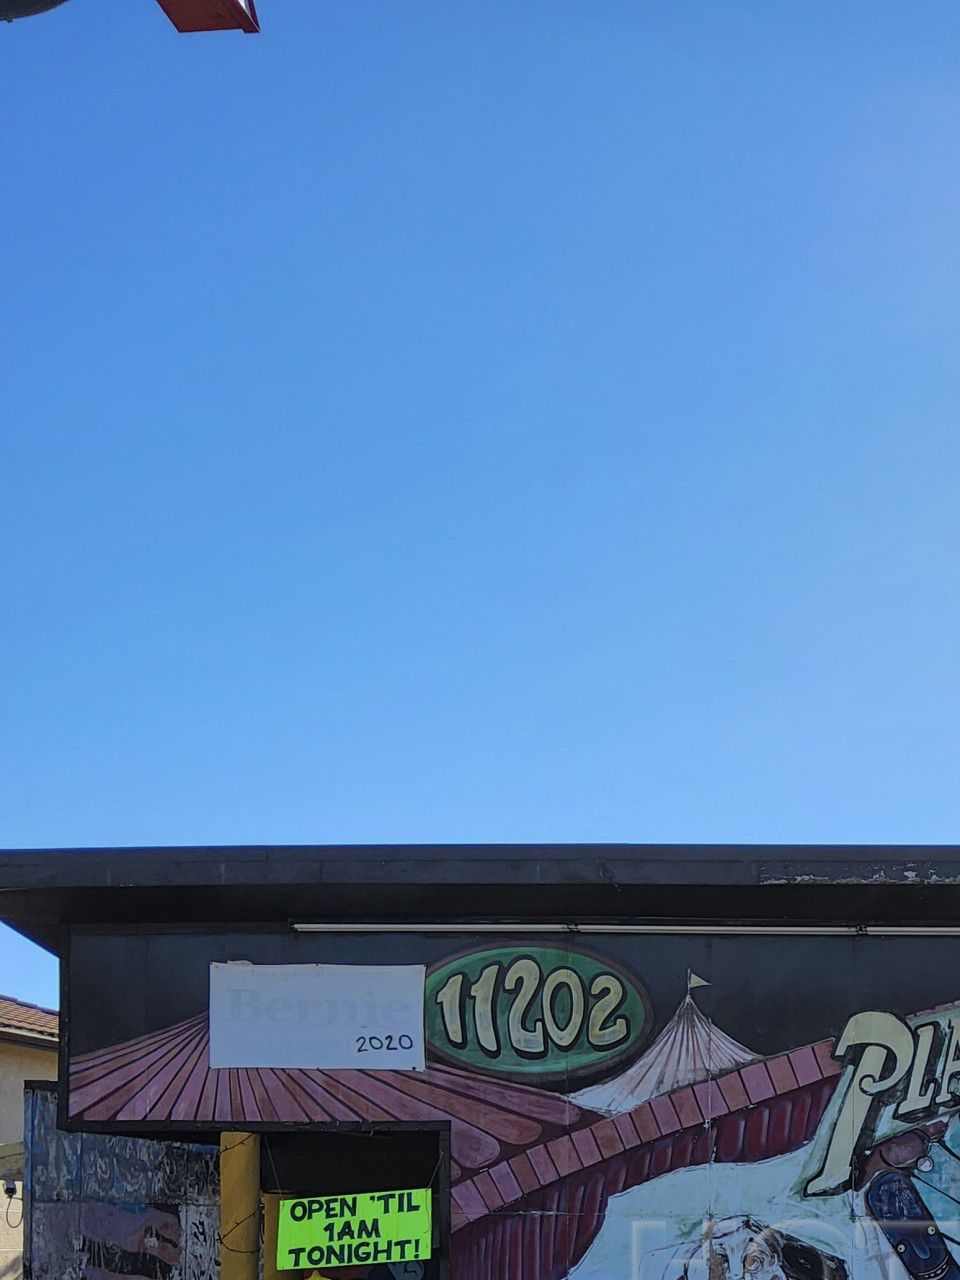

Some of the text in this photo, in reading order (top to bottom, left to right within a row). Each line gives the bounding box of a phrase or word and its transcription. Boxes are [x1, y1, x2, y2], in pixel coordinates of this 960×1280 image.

[436, 955, 632, 1061] 11202
[355, 1034, 414, 1053] 2020
[289, 1191, 421, 1222] OPEN 'TIL
[322, 1217, 382, 1243] 1AM
[288, 1238, 421, 1268] TONIGHT!
